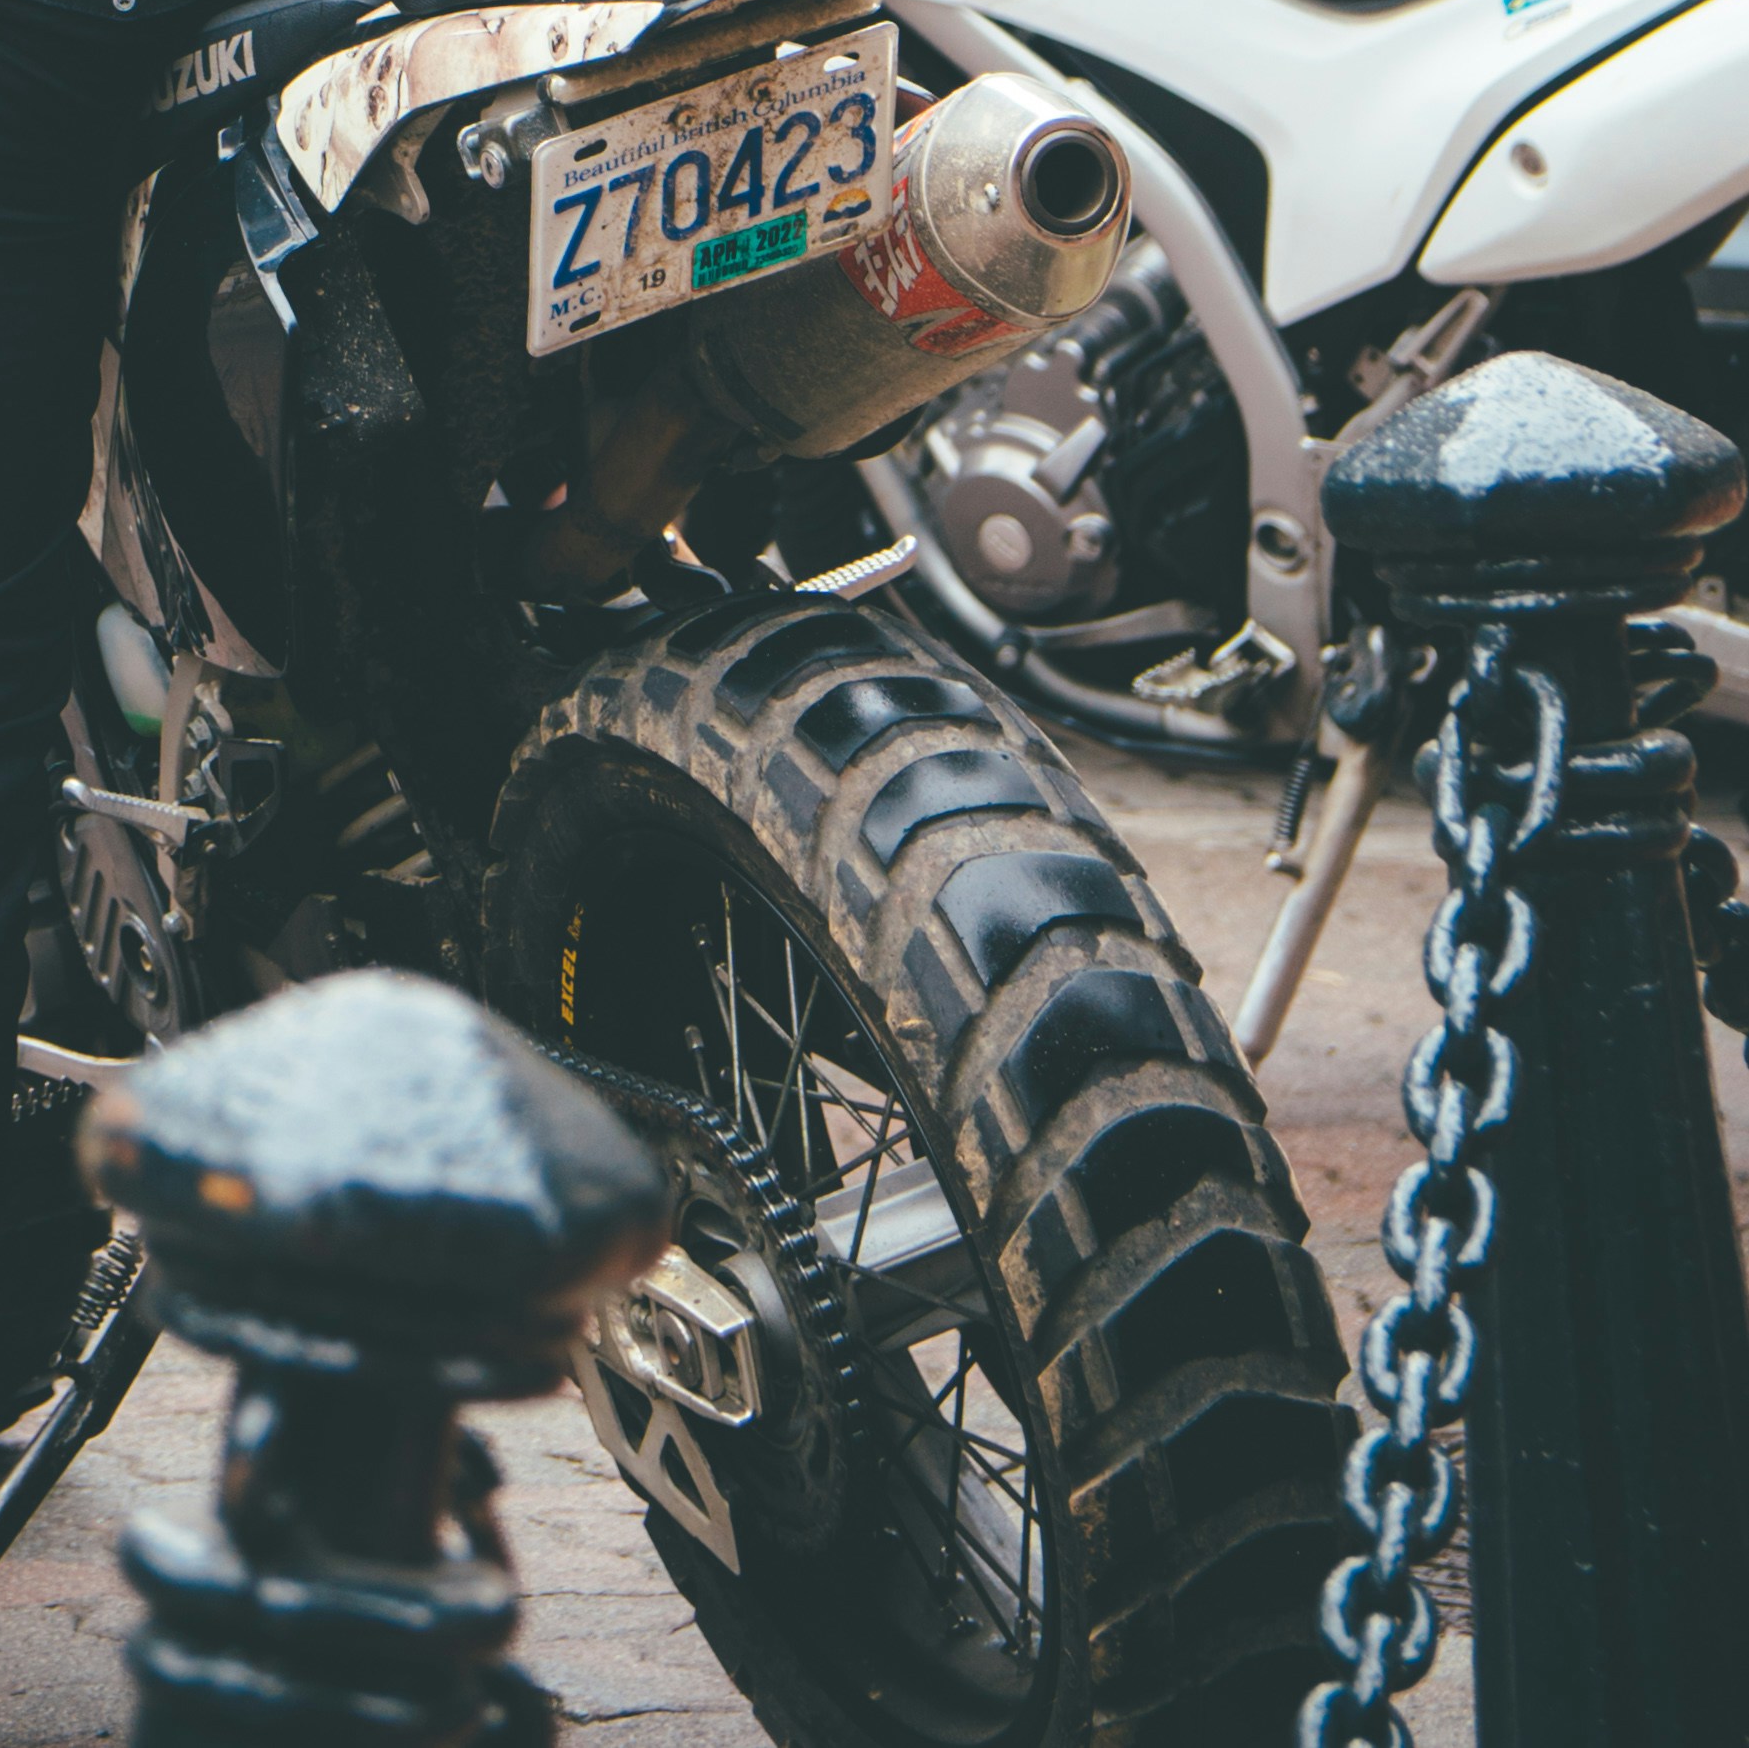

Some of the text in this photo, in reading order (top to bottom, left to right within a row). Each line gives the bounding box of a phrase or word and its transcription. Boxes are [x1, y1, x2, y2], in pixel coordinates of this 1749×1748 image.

[152, 29, 256, 112] UZUKI
[563, 70, 866, 189] Beautiful British Columbia
[553, 92, 877, 290] Z70423
[638, 268, 667, 292] 19
[700, 238, 738, 271] APR
[756, 218, 803, 252] 2022
[549, 286, 602, 321] M.C.
[561, 948, 577, 1025] EXCEL
